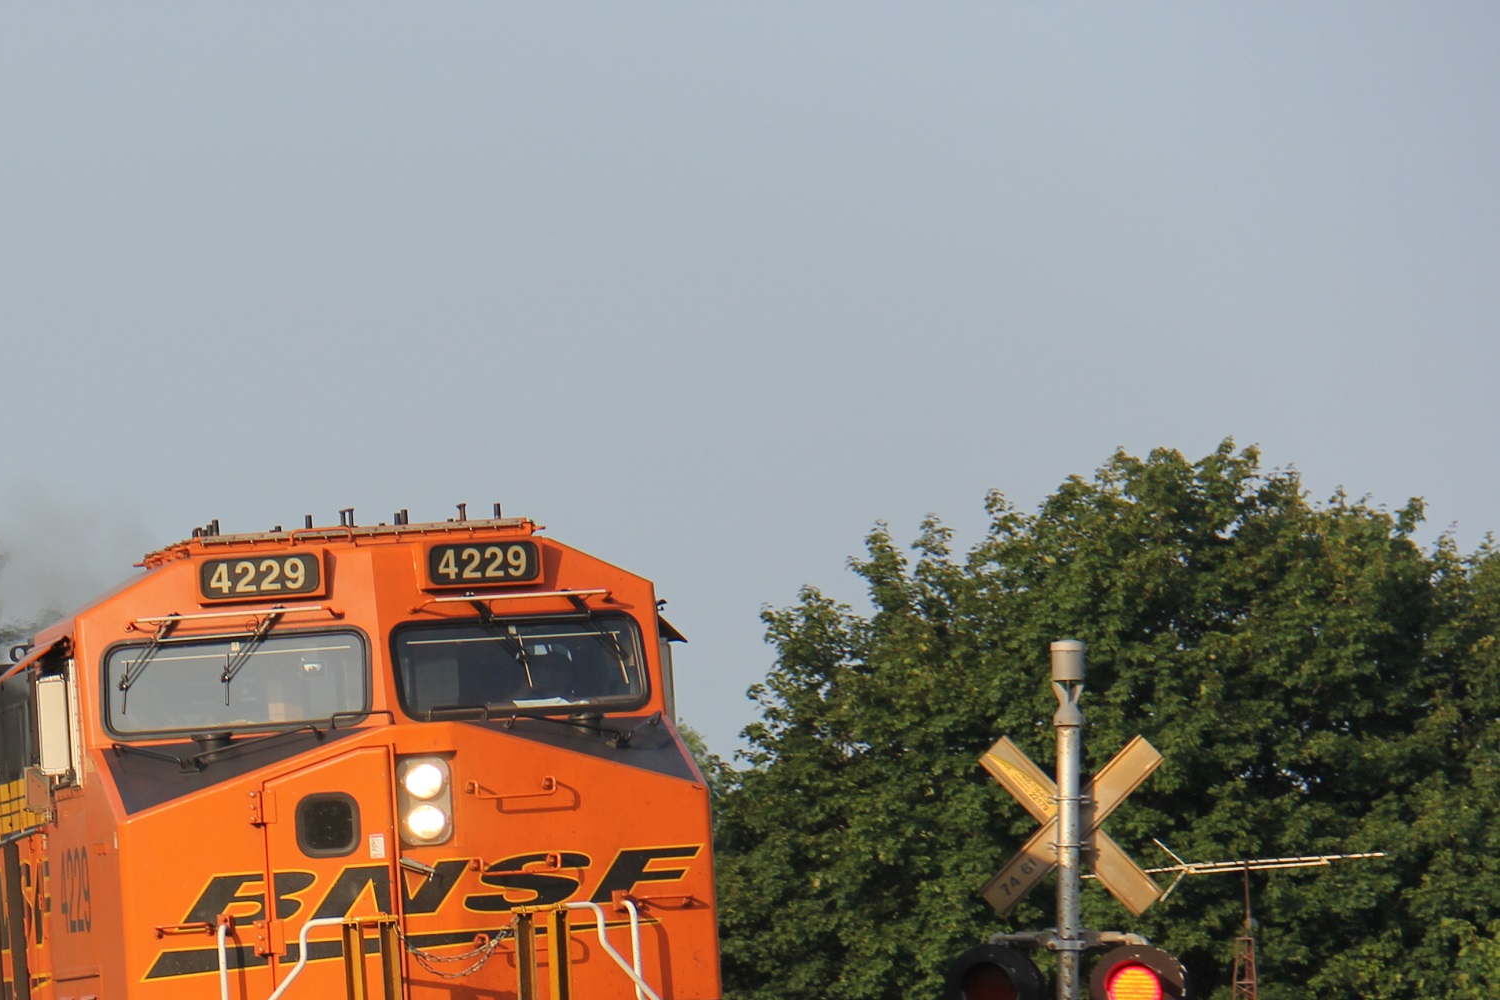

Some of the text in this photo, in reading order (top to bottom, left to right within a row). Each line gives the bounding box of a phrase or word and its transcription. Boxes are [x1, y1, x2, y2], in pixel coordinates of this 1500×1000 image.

[209, 556, 307, 594] 4229
[438, 545, 528, 580] 4229
[61, 845, 91, 933] 4229
[174, 843, 705, 930] BNSF
